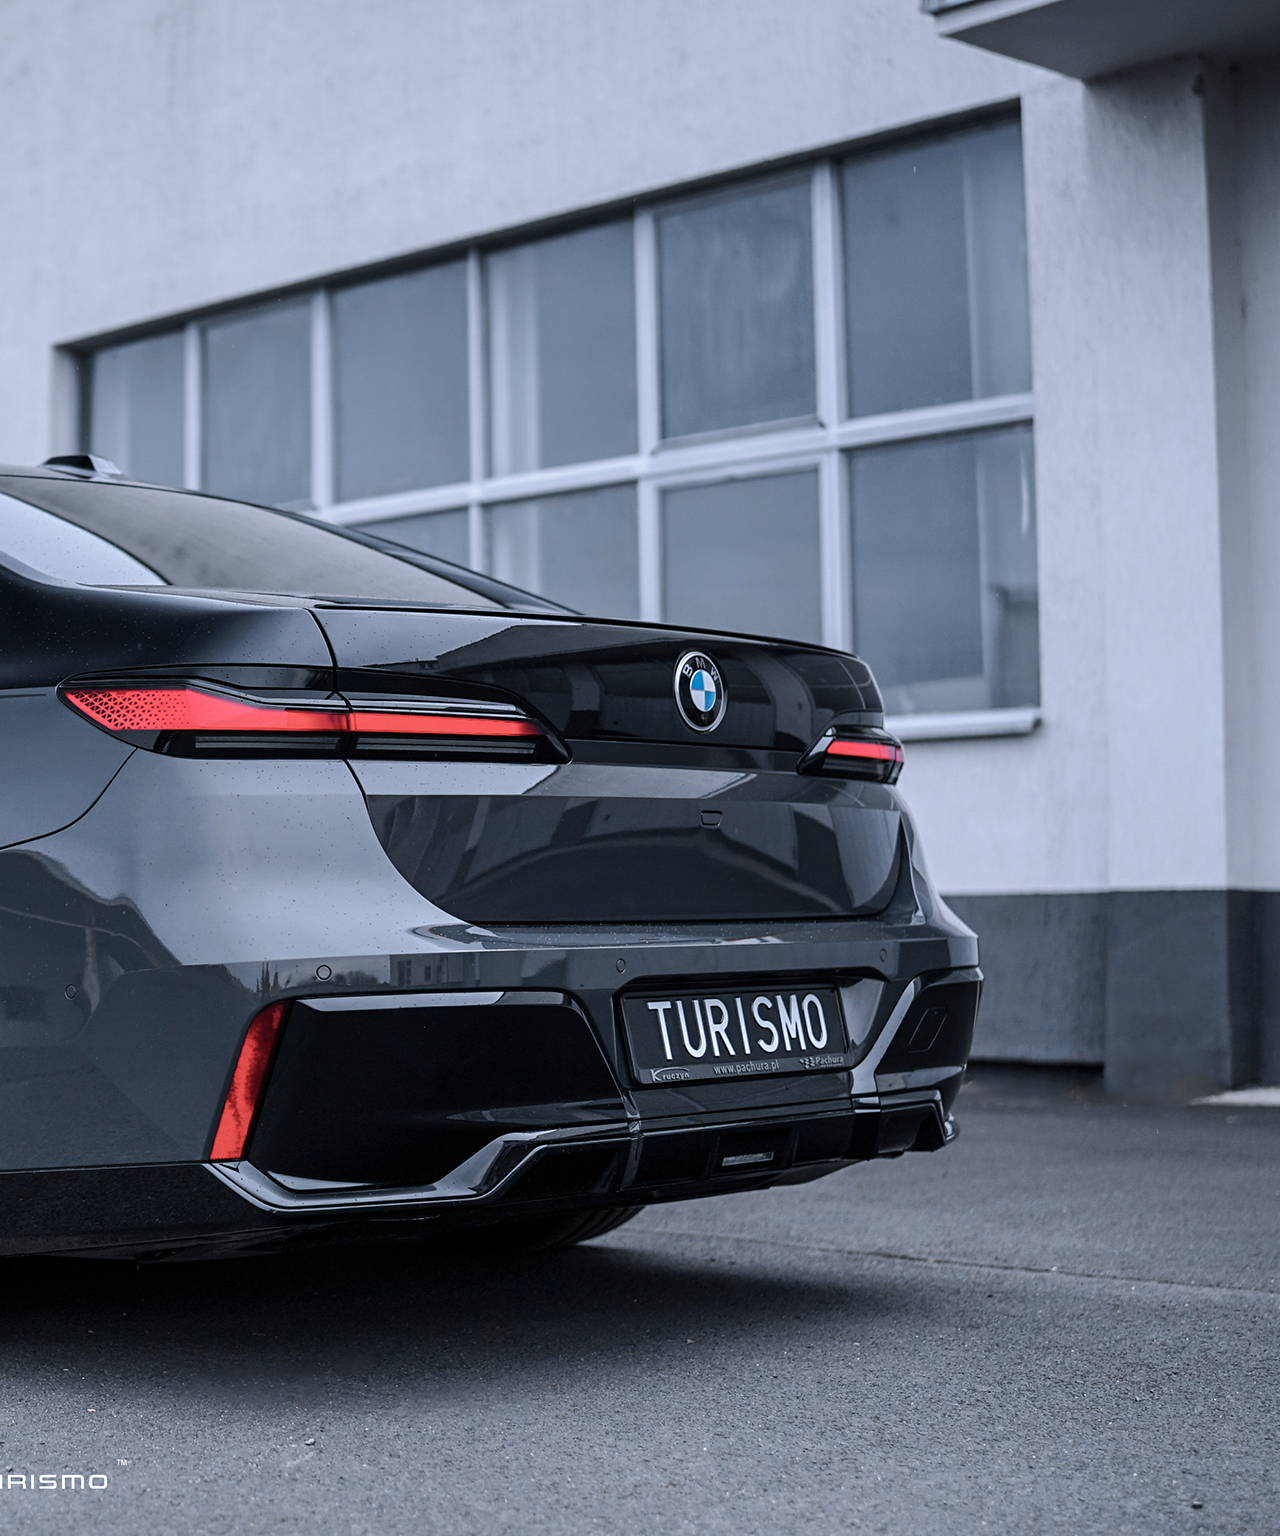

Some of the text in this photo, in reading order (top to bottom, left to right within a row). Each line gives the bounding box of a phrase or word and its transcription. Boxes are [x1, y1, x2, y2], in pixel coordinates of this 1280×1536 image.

[682, 657, 719, 682] BMW
[647, 993, 828, 1060] TURISMO
[713, 1060, 780, 1076] www.pachura.pl
[815, 1055, 844, 1065] Pachura
[650, 1067, 690, 1082] Kruczyn
